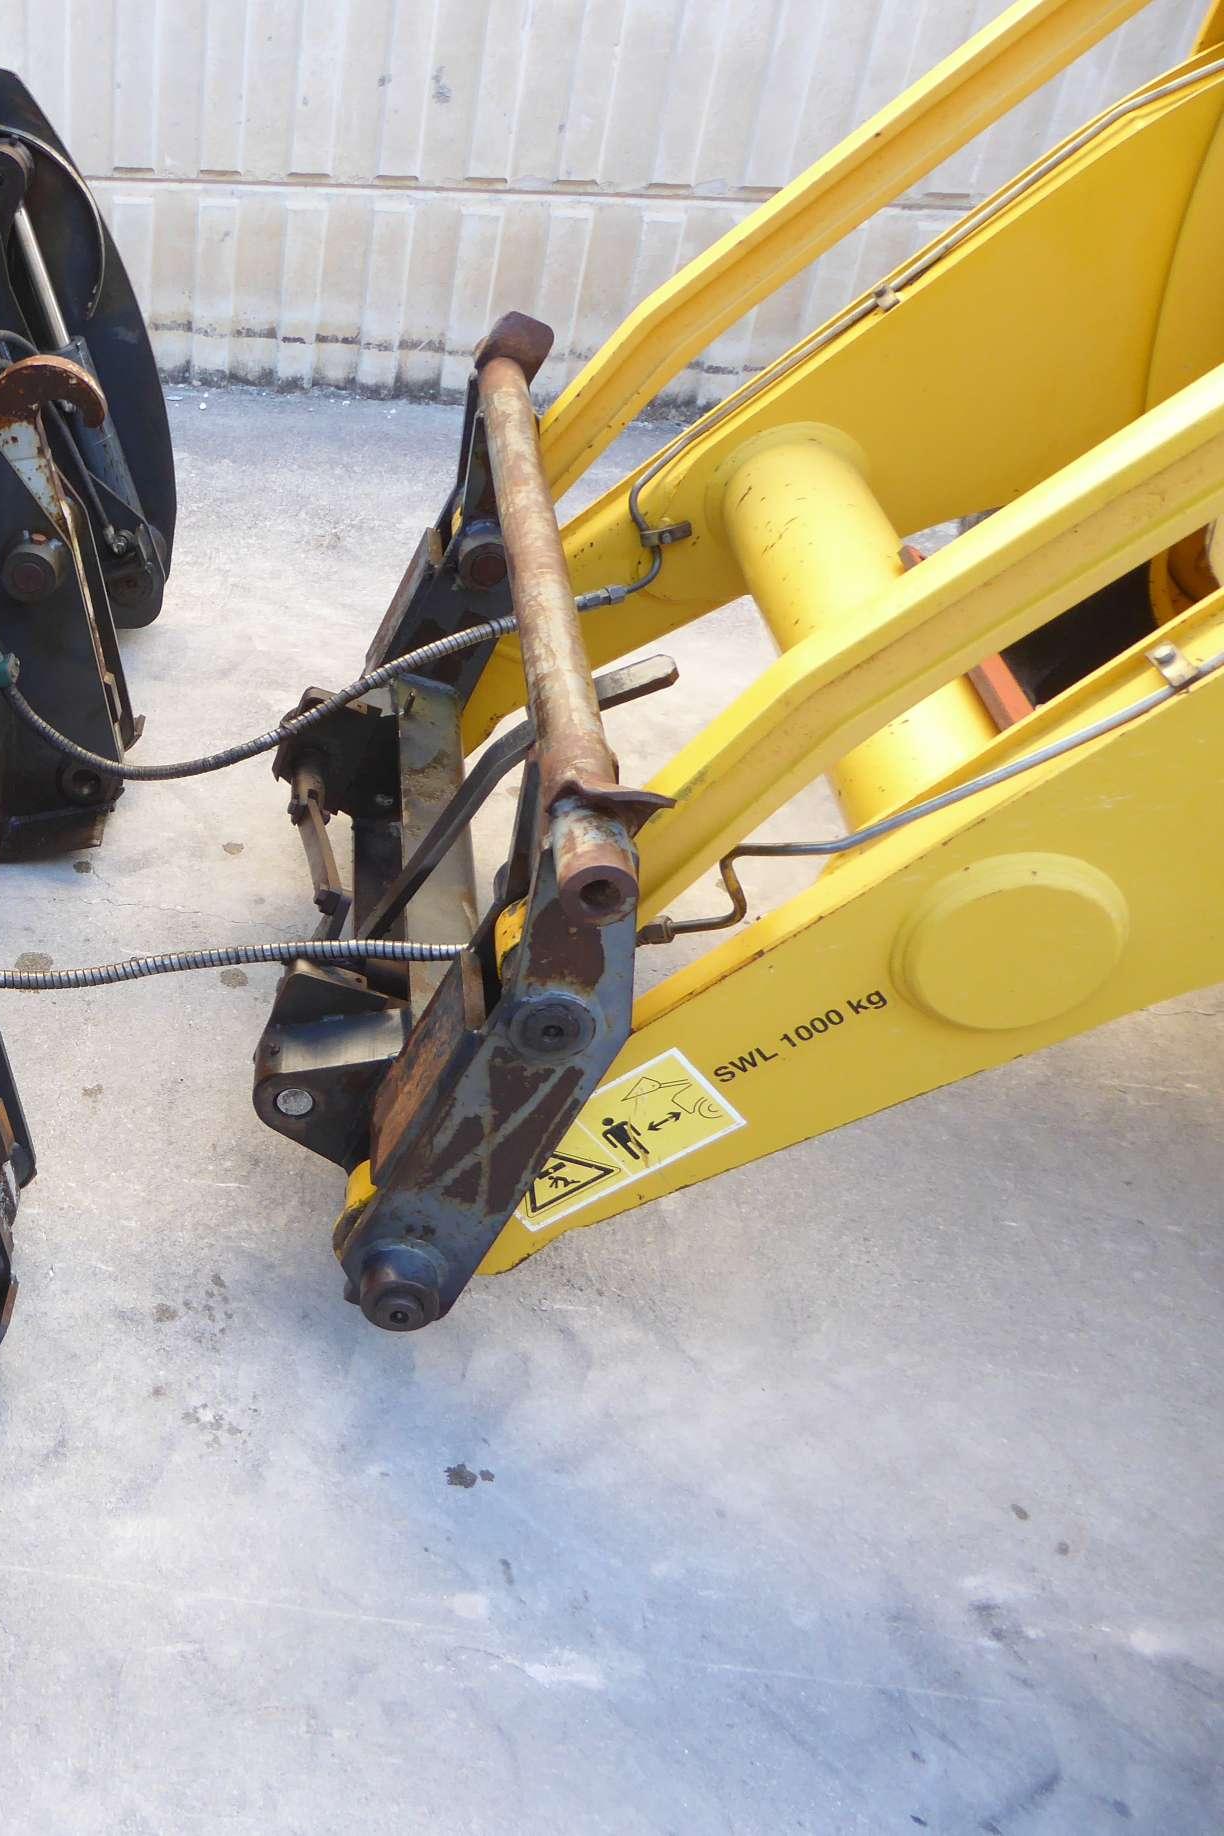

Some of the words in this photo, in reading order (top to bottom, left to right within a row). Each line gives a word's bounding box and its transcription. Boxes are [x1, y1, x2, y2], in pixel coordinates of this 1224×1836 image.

[713, 1047, 778, 1082] SWL
[779, 1009, 844, 1047] 1000
[846, 990, 888, 1014] kg
